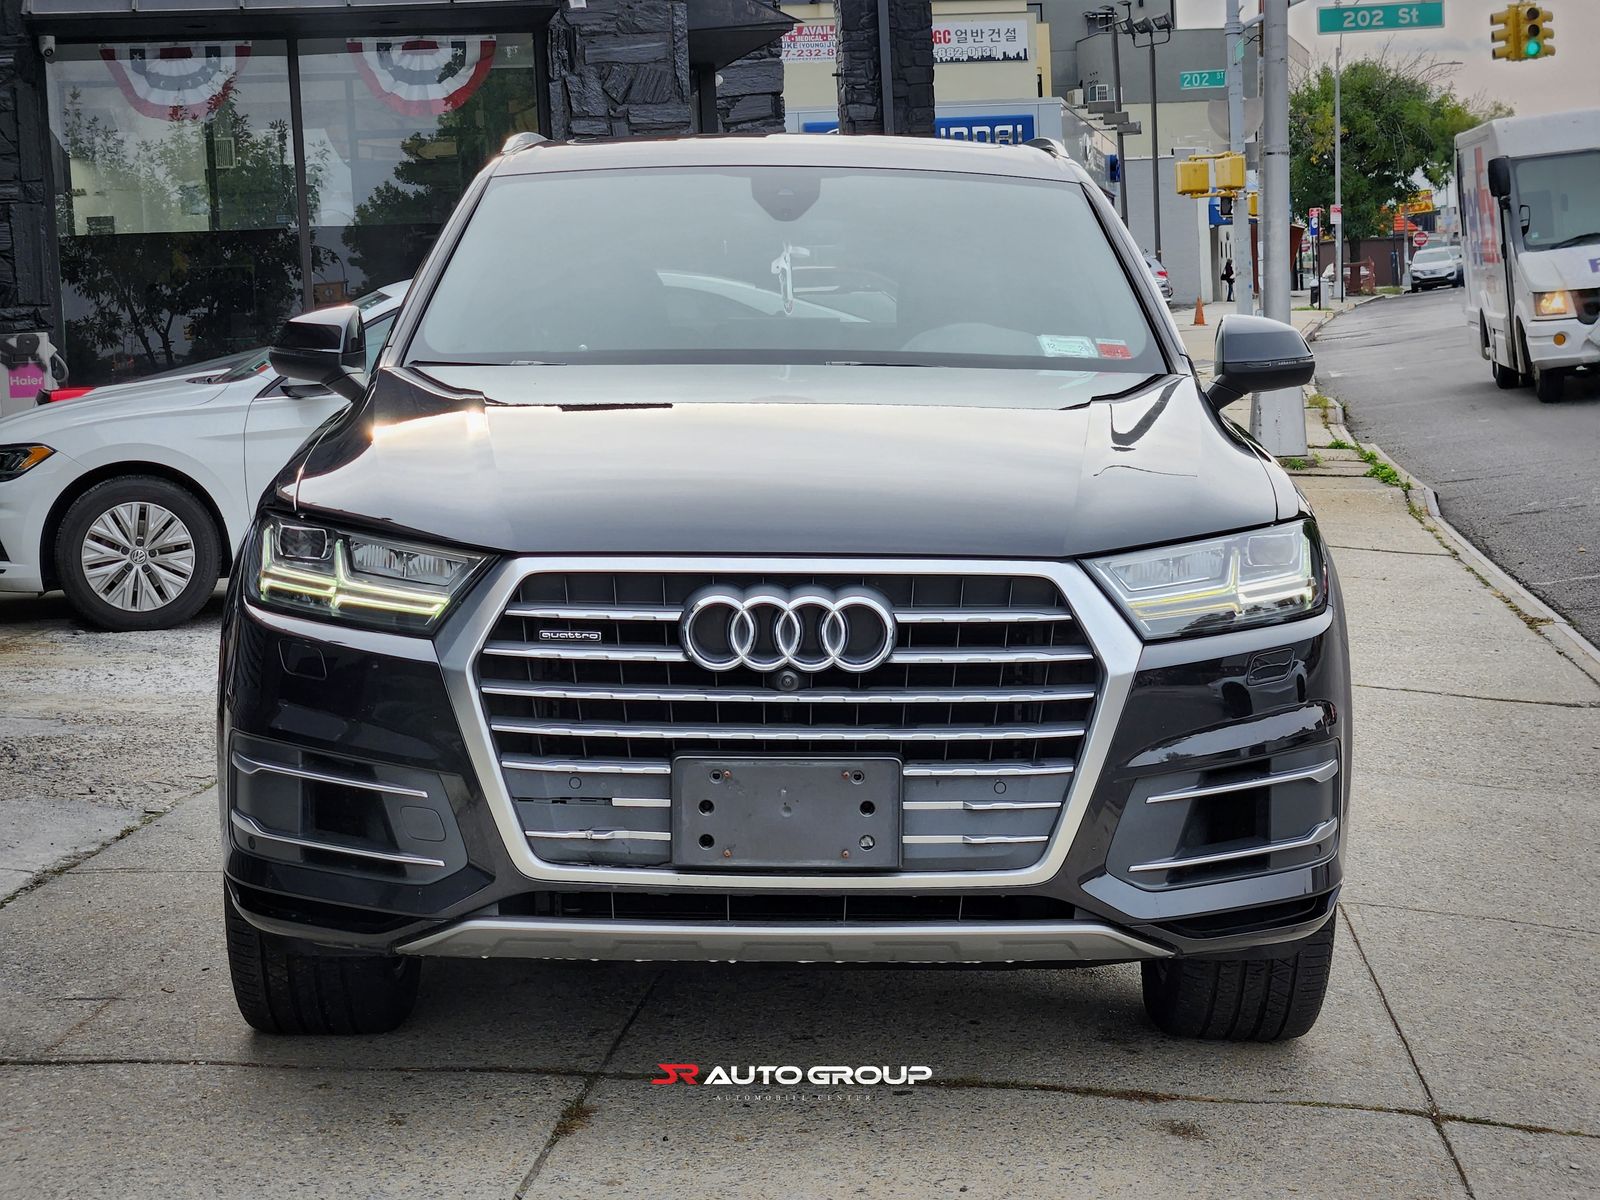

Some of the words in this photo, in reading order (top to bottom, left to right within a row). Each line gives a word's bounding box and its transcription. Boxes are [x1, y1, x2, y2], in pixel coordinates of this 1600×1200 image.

[1343, 10, 1384, 27] 202
[1398, 8, 1419, 24] St
[1183, 73, 1209, 87] 202
[10, 375, 43, 386] Haier
